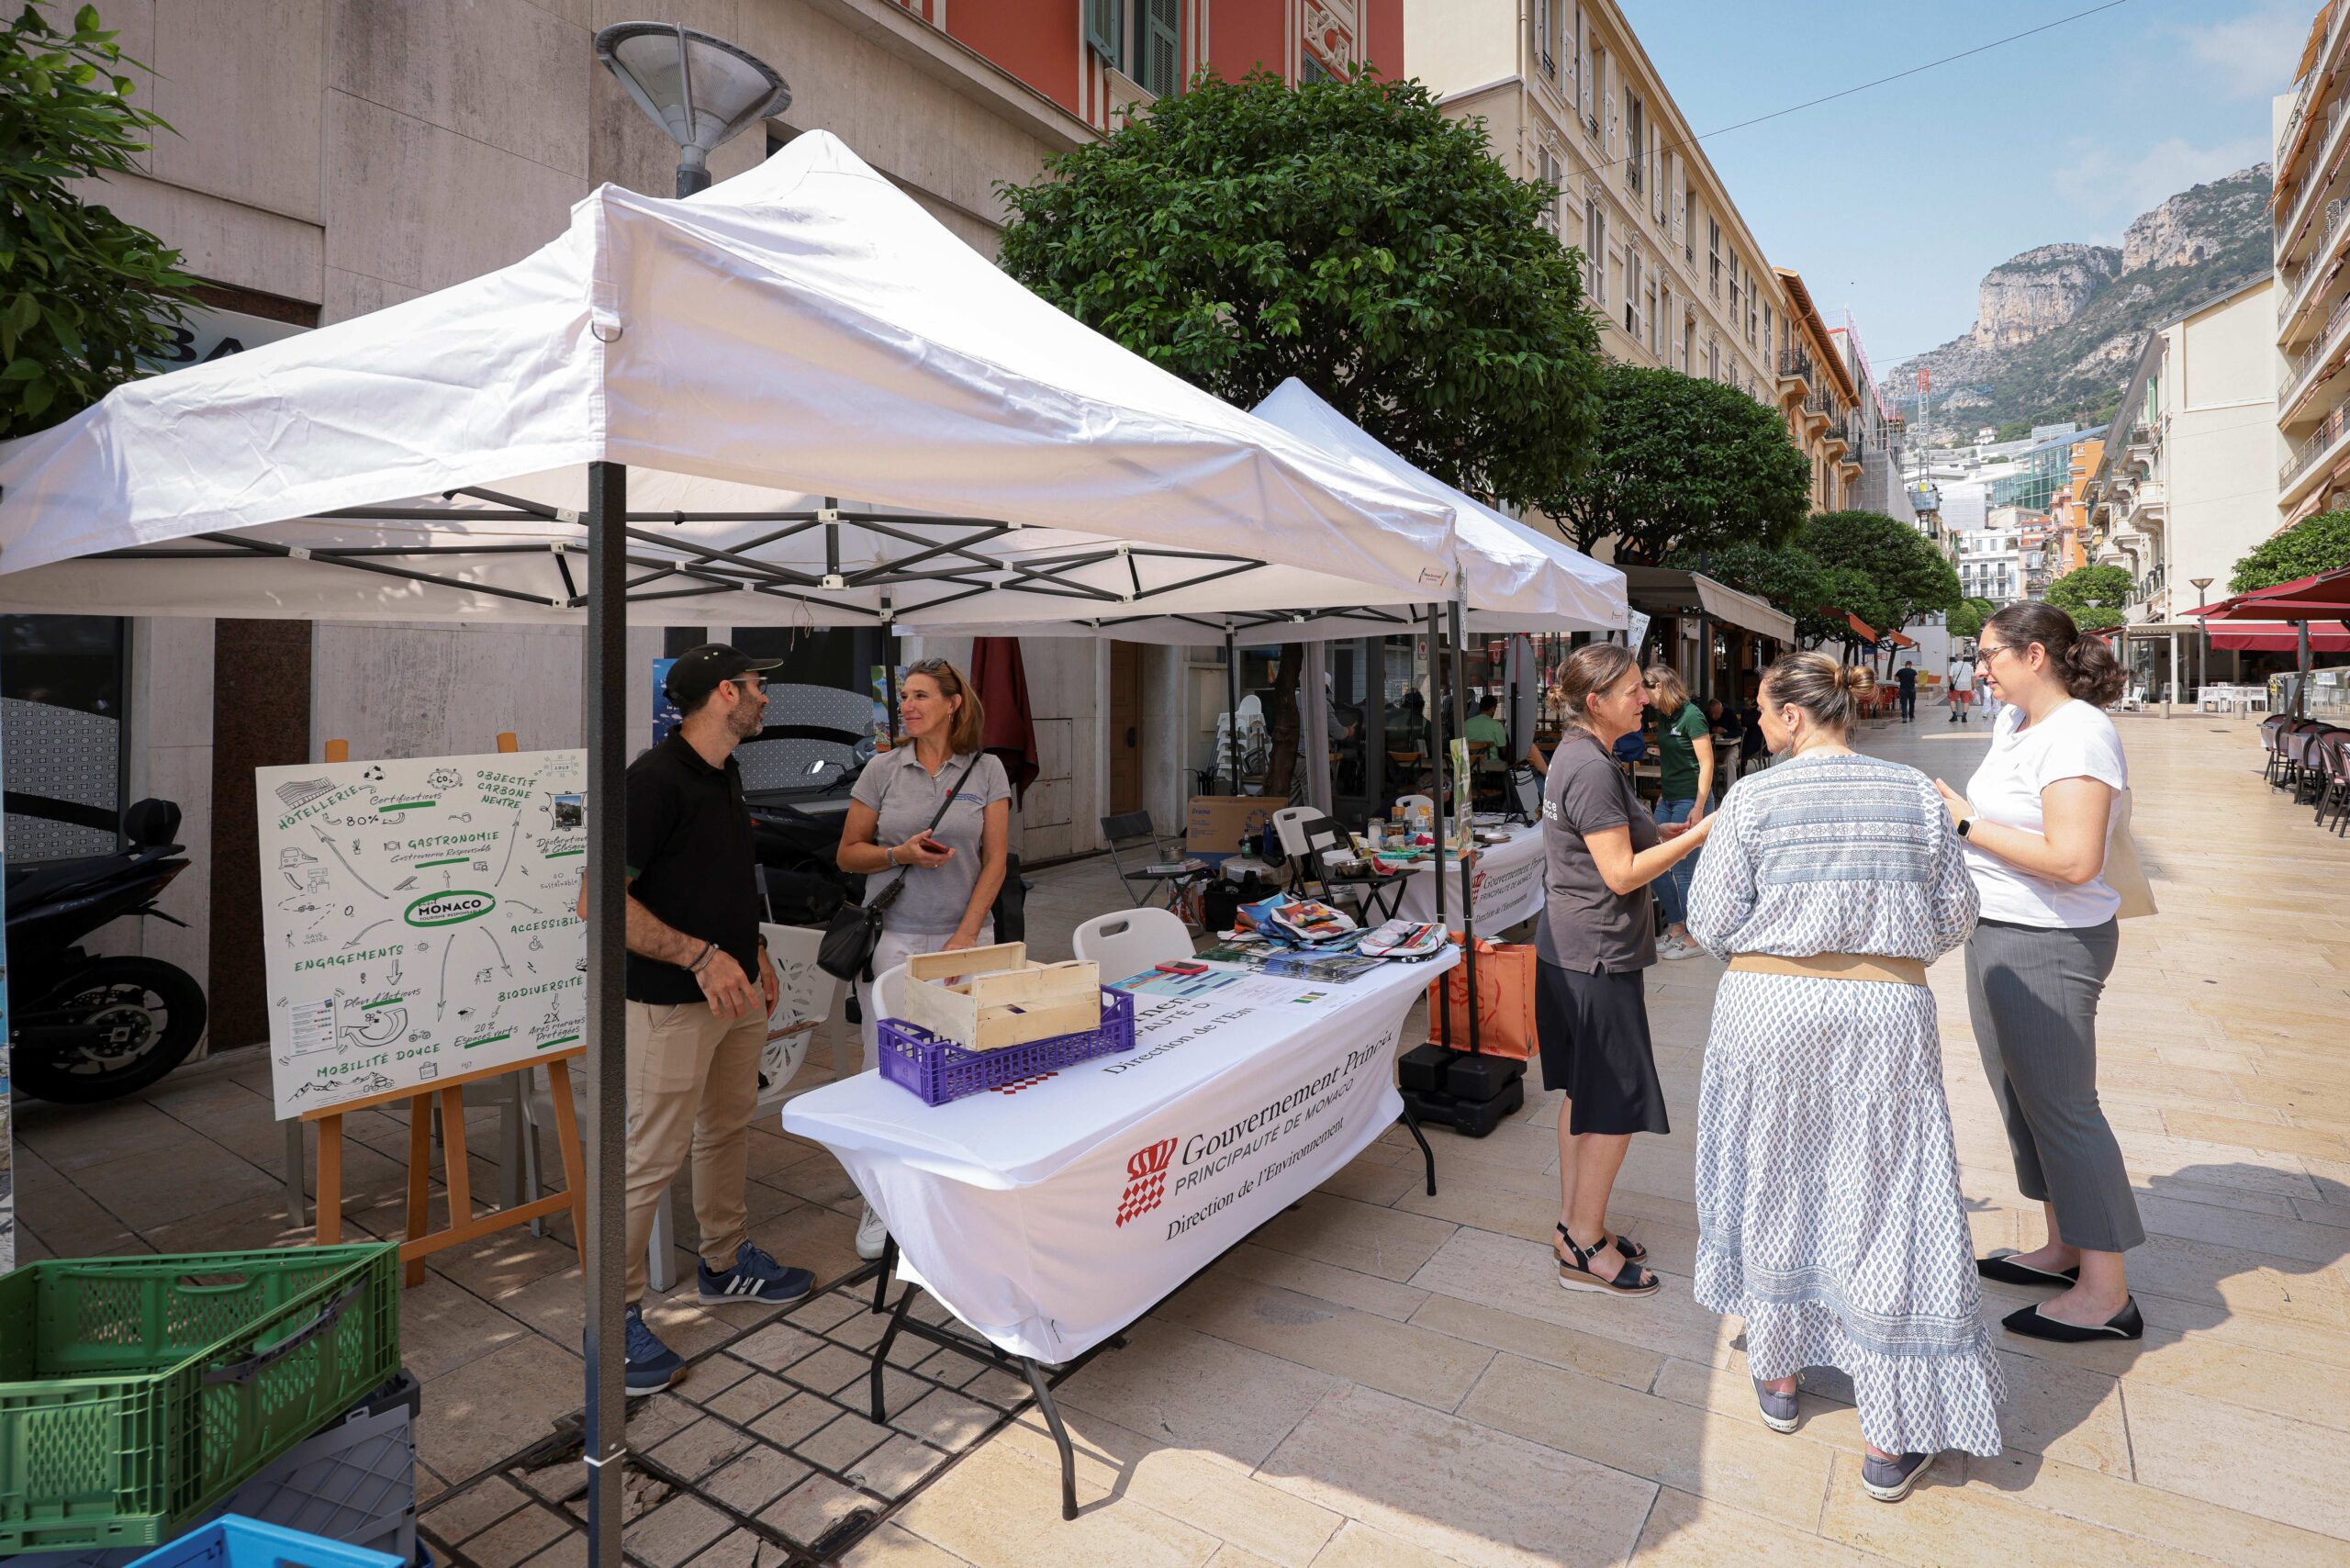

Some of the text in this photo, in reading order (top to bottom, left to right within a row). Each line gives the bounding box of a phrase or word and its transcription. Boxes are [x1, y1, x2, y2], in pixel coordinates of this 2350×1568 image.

[476, 770, 537, 788] OBJECTIF
[369, 792, 442, 805] Certifications
[477, 782, 532, 799] CARBONE
[278, 785, 359, 830] HÔTELLERIE
[481, 794, 522, 809] NEUTRE
[346, 814, 379, 826] 80%
[408, 831, 499, 849] GASTRONOMIE
[540, 845, 550, 854] de
[390, 845, 491, 863] Gastronomie Responsable
[419, 899, 482, 915] MONACO
[510, 916, 584, 935] ACCESSIBIL
[295, 945, 404, 971] ENGAGEMENTS
[344, 988, 421, 1009] Plan d'Actions
[498, 976, 584, 1002] BIODIVERSITÉ
[528, 1016, 586, 1036] Aires marines
[536, 1025, 580, 1042] Protégées
[453, 1025, 519, 1047] Espaces verts
[1102, 1025, 1217, 1074] Direction de
[317, 1043, 441, 1078] MOBILITÉ DOUCE
[1181, 1066, 1340, 1166] Gouvernement
[1175, 1078, 1354, 1196] PRINCIPAUTÉ DE MONACO
[1165, 1116, 1344, 1240] Direction de l'Environnement
